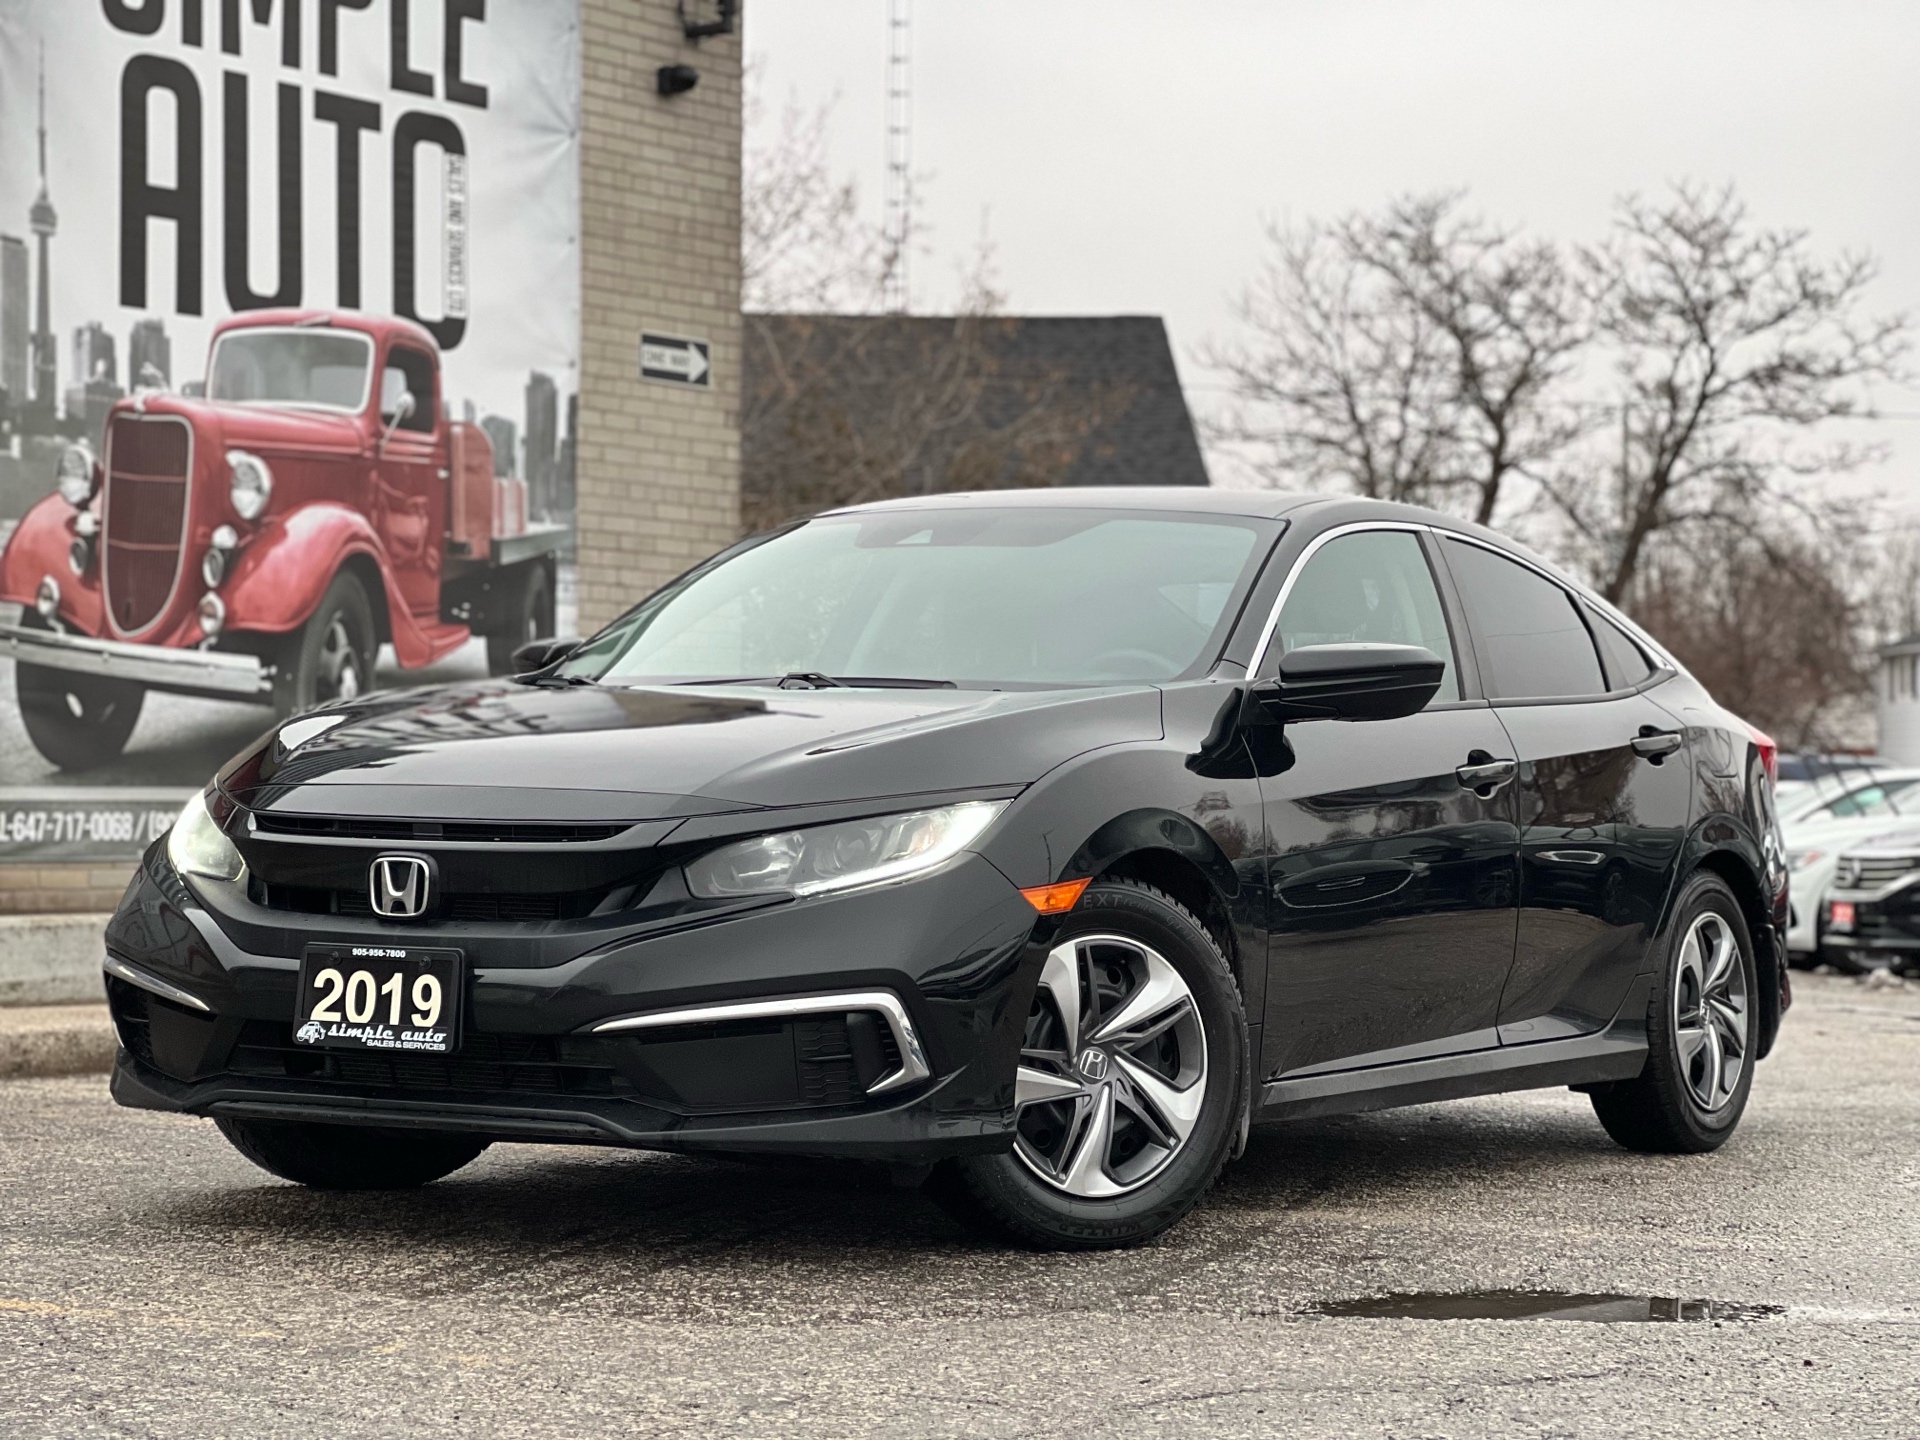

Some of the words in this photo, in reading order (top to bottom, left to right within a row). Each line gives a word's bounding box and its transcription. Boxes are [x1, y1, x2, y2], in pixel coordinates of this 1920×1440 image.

[120, 54, 467, 350] AUTO
[352, 948, 406, 958] 905-956-7800
[310, 968, 442, 1027] 2019
[327, 1023, 394, 1042] simple
[401, 1027, 447, 1043] auto
[366, 1039, 394, 1048] SALES
[403, 1041, 445, 1051] SERVICES
